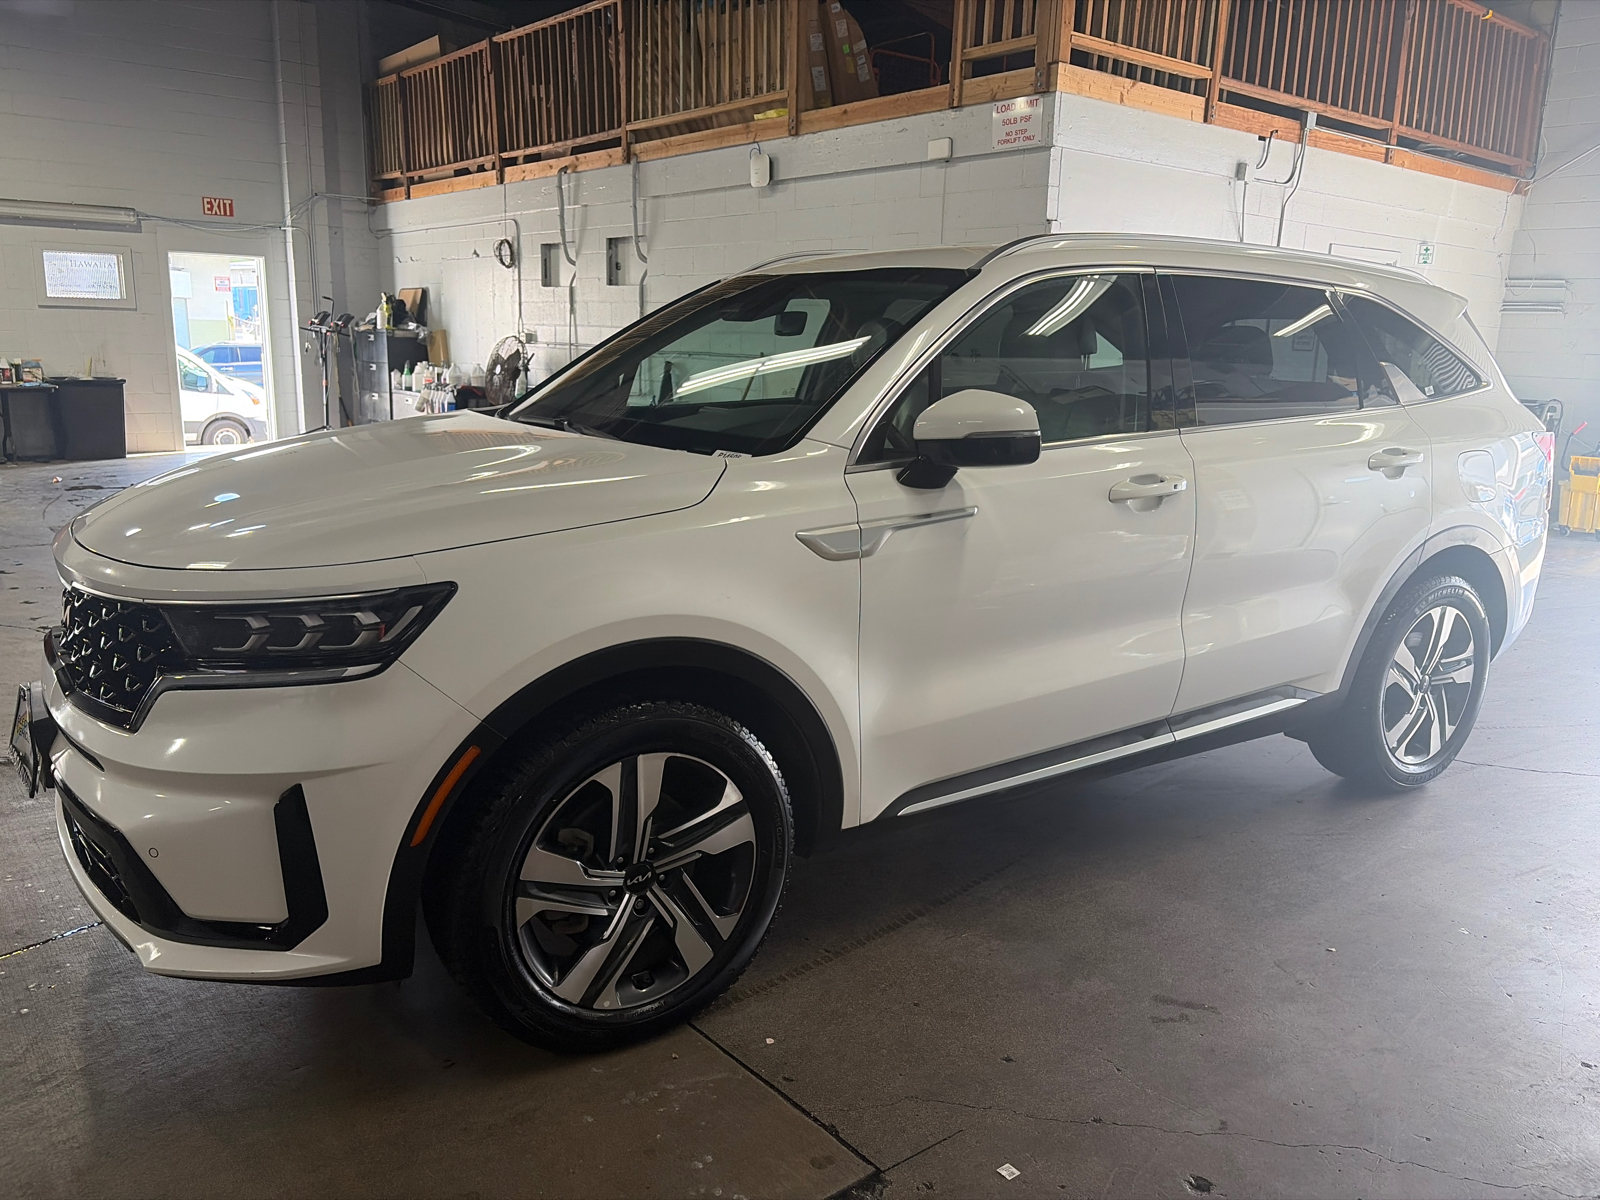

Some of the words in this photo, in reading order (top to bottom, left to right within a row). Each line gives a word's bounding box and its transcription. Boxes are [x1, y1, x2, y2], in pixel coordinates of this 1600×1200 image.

[996, 103, 1016, 114] LOAD
[1002, 117, 1018, 126] 50LB
[1020, 114, 1032, 123] PSF
[1015, 128, 1028, 136] STEP
[997, 136, 1021, 146] FORKLIFT
[1022, 134, 1036, 142] ONLY
[203, 197, 232, 216] EXIT
[1428, 588, 1464, 601] MICHELIN
